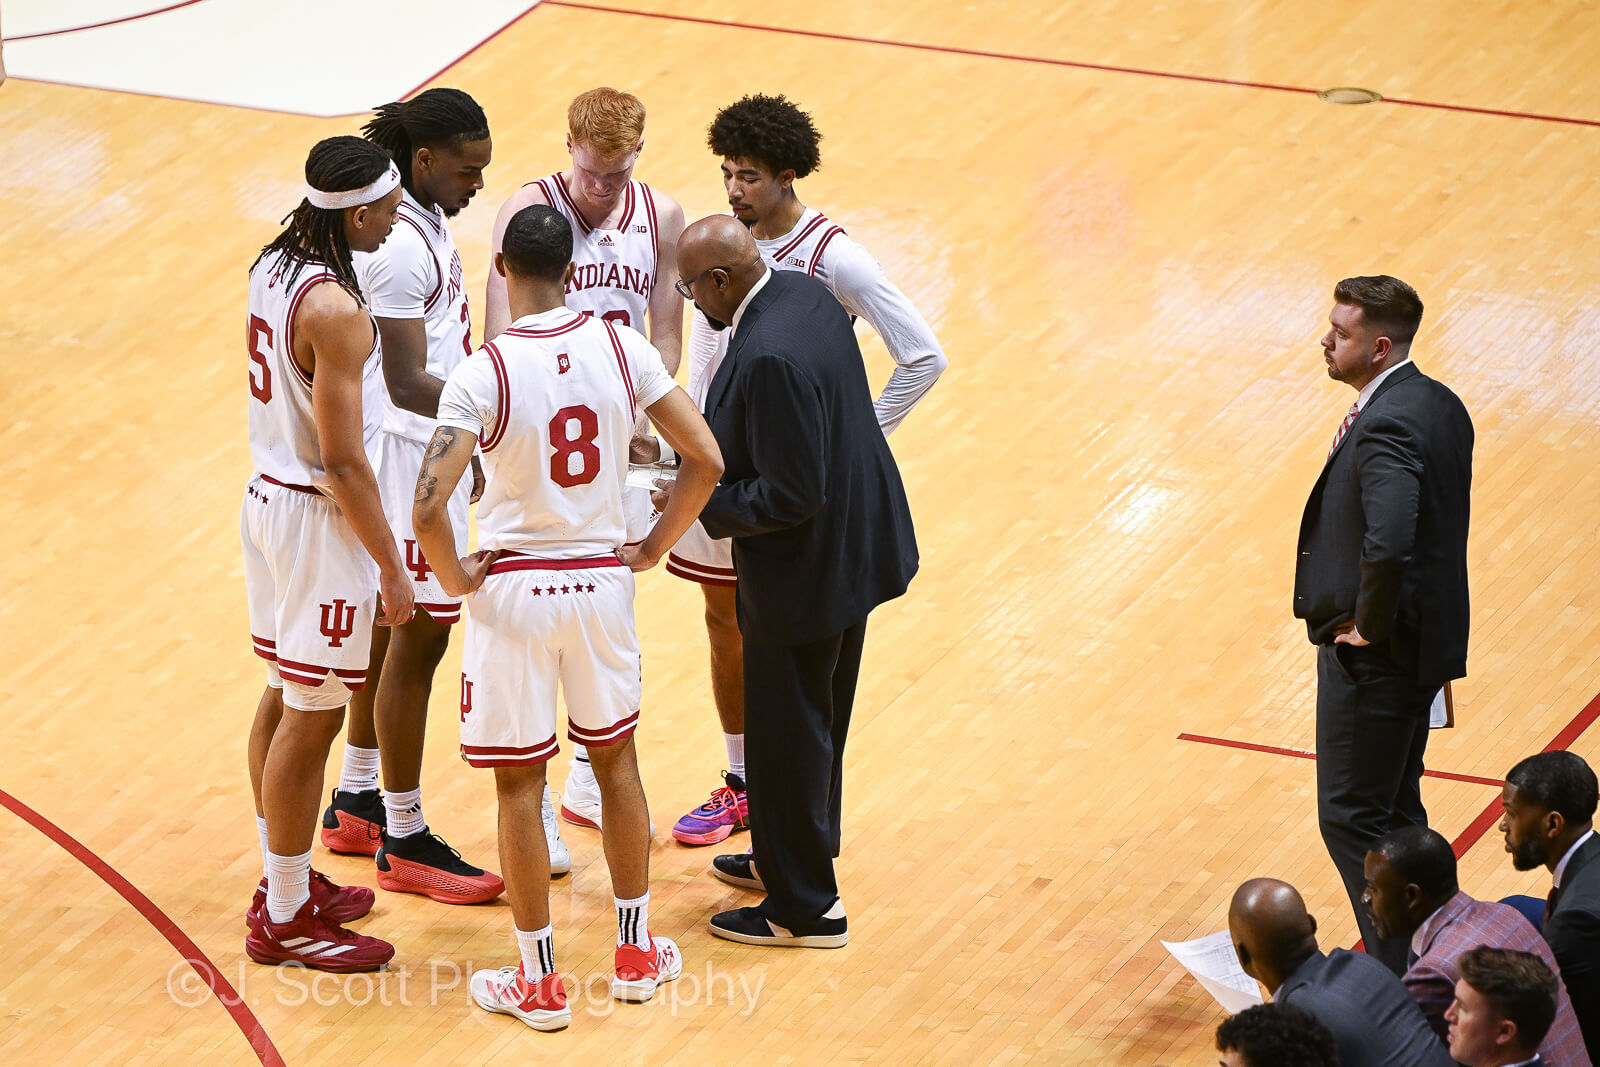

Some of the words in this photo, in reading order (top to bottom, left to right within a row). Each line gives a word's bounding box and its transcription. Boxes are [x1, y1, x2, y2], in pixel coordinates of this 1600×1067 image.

[564, 263, 650, 300] NDIANA
[248, 312, 274, 406] 5
[548, 403, 601, 489] 8
